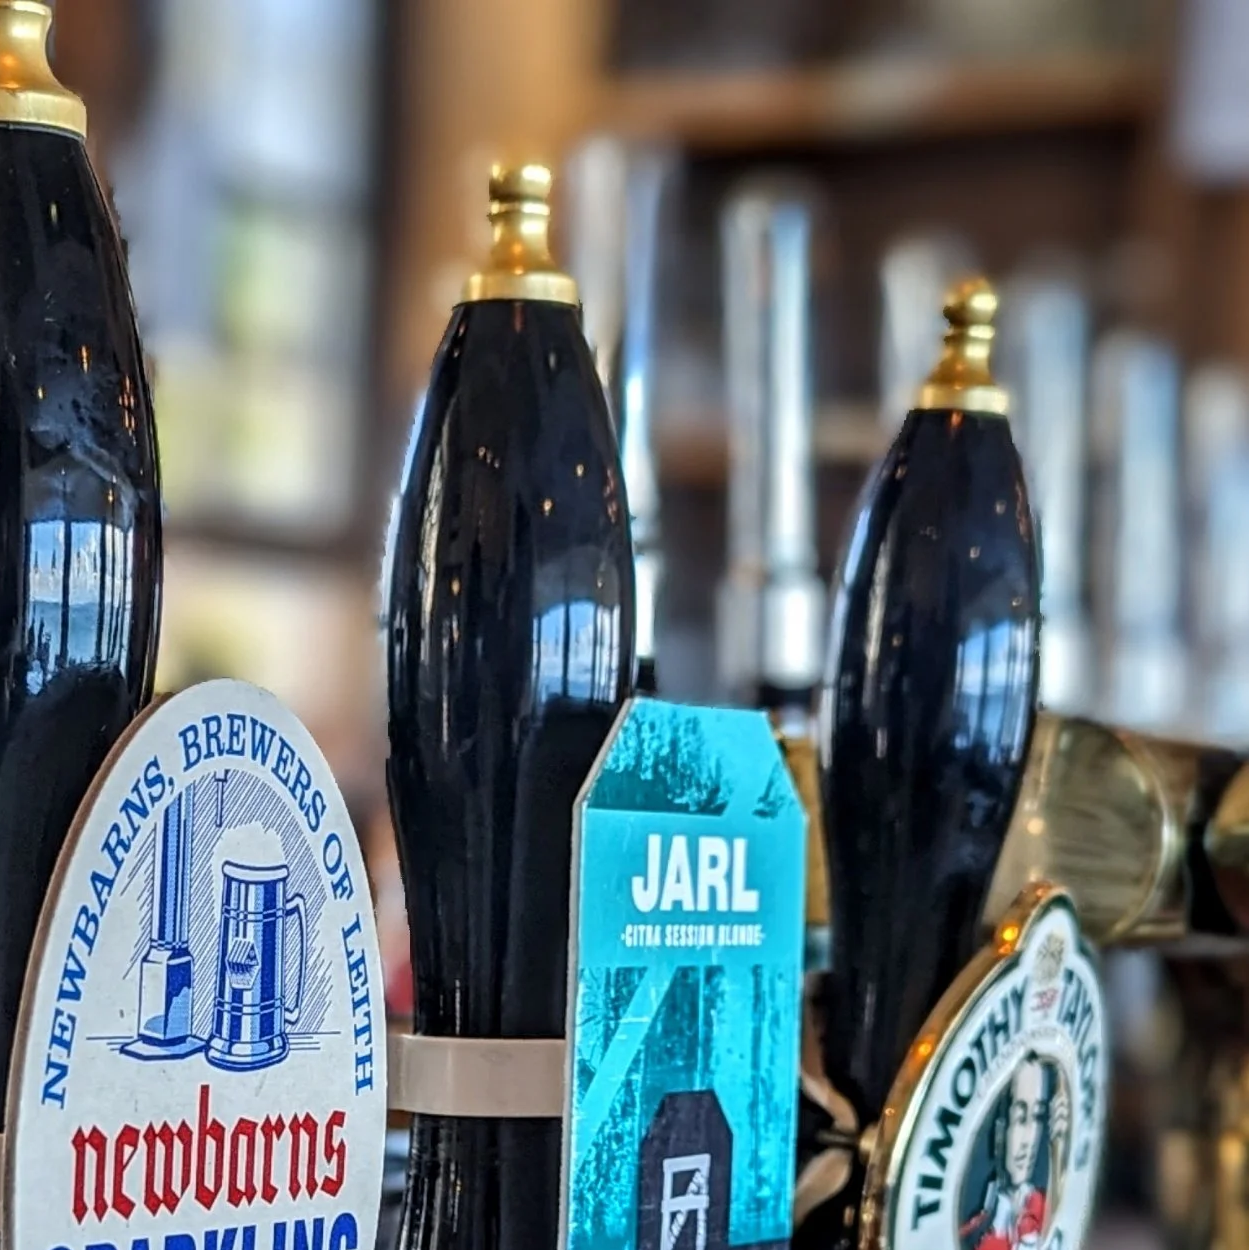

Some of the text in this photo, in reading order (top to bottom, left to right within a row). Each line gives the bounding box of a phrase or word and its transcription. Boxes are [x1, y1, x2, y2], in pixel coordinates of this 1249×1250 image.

[41, 713, 374, 1109] NEWBARNS, BREWERS OF LEITH
[625, 923, 662, 947] CITRA
[664, 923, 714, 947] SESSION
[631, 834, 760, 913] JARL
[71, 1084, 347, 1225] newbarns
[910, 976, 1029, 1232] TIMOTHY
